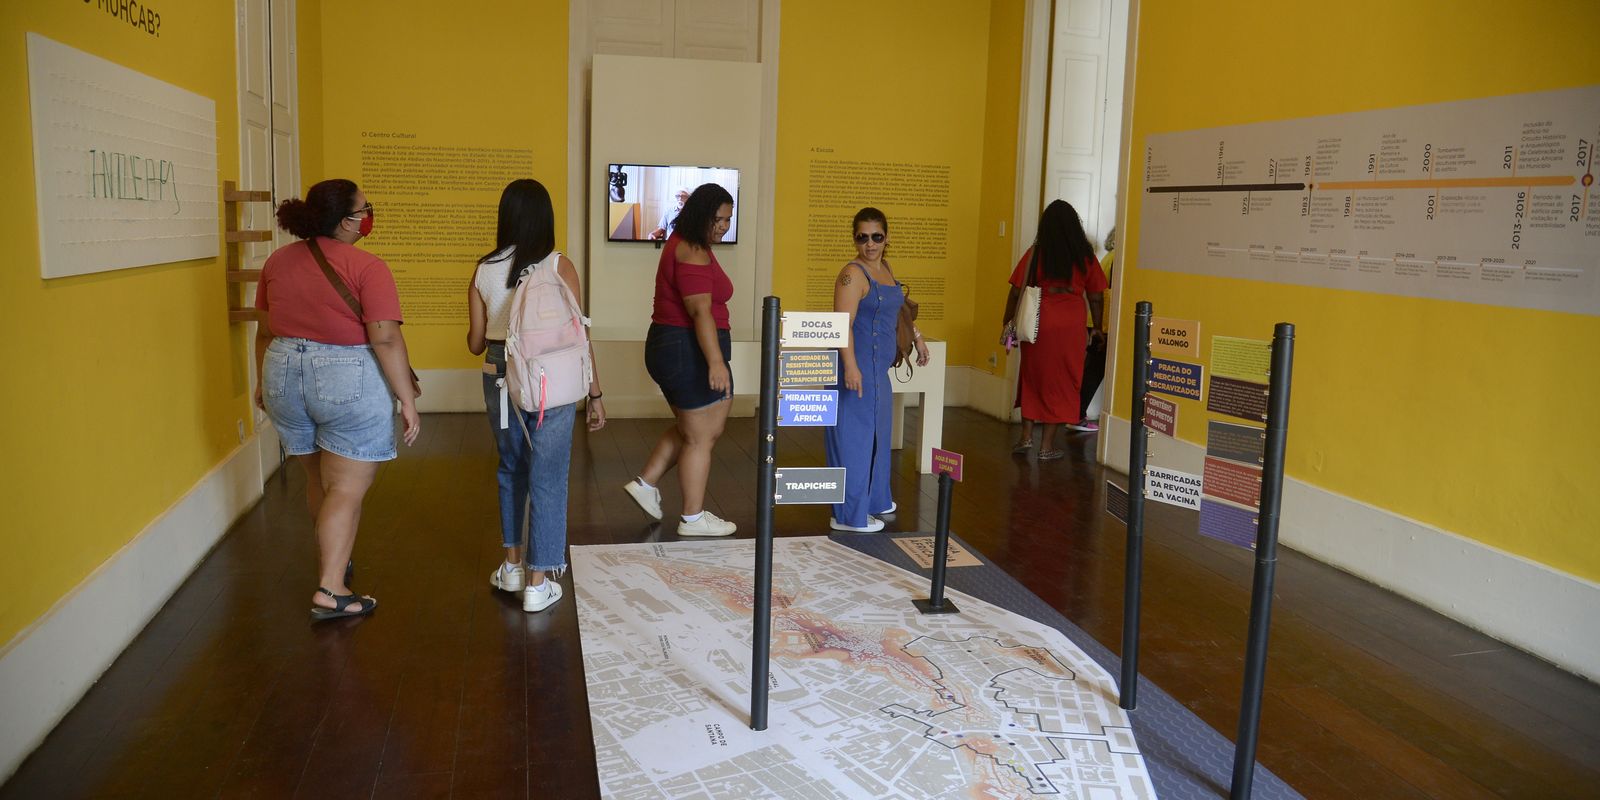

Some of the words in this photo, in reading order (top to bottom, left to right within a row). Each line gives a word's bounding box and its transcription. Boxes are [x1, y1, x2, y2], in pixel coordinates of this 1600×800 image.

[1423, 144, 1431, 172] 2000
[1503, 145, 1513, 169] 2011
[1577, 139, 1588, 167] 2017
[1427, 195, 1436, 220] 2001
[1570, 194, 1581, 222] 2017
[1512, 192, 1526, 249] 2013-2016
[792, 331, 840, 340] REBOUÇAS
[1158, 338, 1189, 348] VALONGO
[1159, 364, 1180, 374] PRAÇA
[1154, 372, 1185, 384] MERCADO
[1150, 382, 1199, 396] ESCRAVIZADOS
[794, 413, 823, 422] ÁFRICA
[1156, 411, 1173, 424] PRETOS
[1151, 420, 1167, 432] NOVOS
[1150, 471, 1201, 487] BARRICADAS
[1150, 481, 1162, 490] DA
[1164, 483, 1200, 496] REVOLTA
[1153, 491, 1164, 499] DA
[1166, 493, 1196, 506] VACINA
[705, 724, 717, 745] SANTANA
[714, 724, 725, 740] CAMPO
